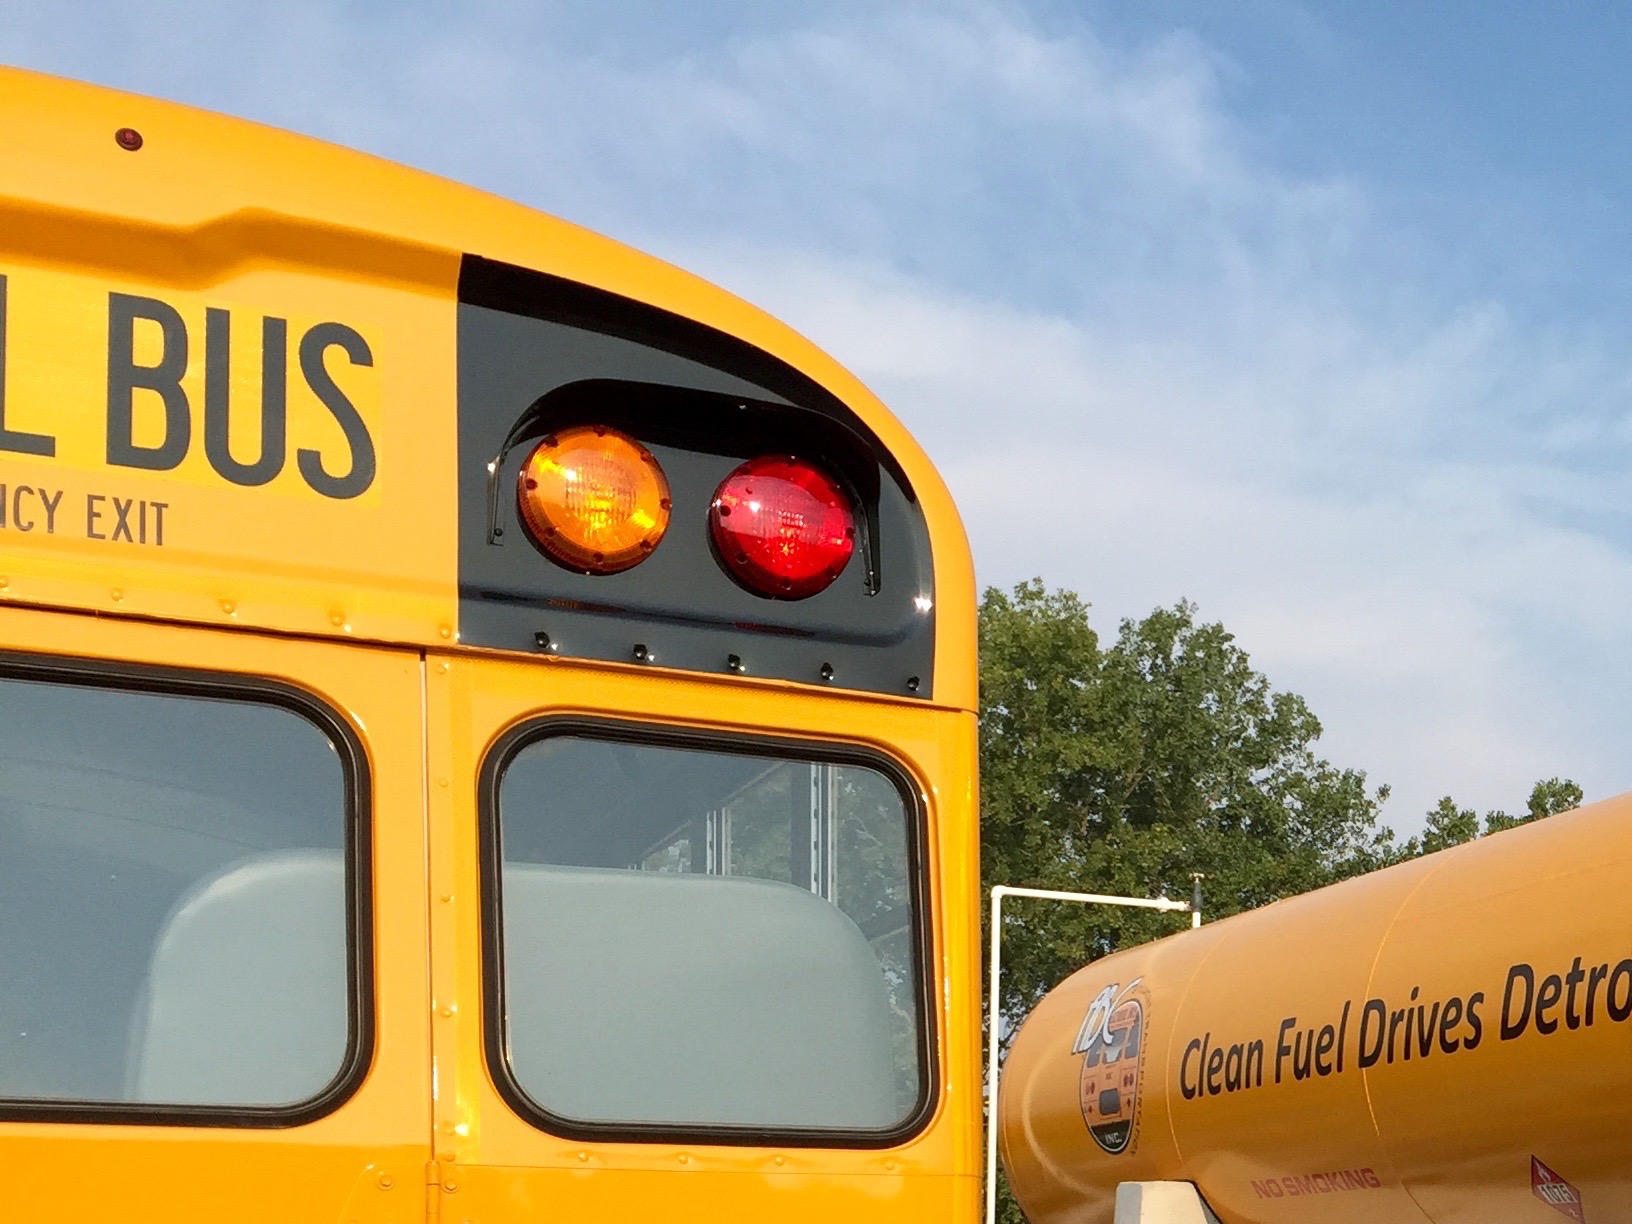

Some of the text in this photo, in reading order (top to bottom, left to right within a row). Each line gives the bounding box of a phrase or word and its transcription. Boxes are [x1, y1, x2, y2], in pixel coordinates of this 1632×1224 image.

[107, 291, 377, 500] BUS
[87, 494, 169, 546] EXIT
[1179, 1031, 1263, 1100] Clean
[1274, 1001, 1351, 1084] Fuel
[1358, 987, 1485, 1070] Drives
[1250, 1167, 1382, 1199] NO SMOKING
